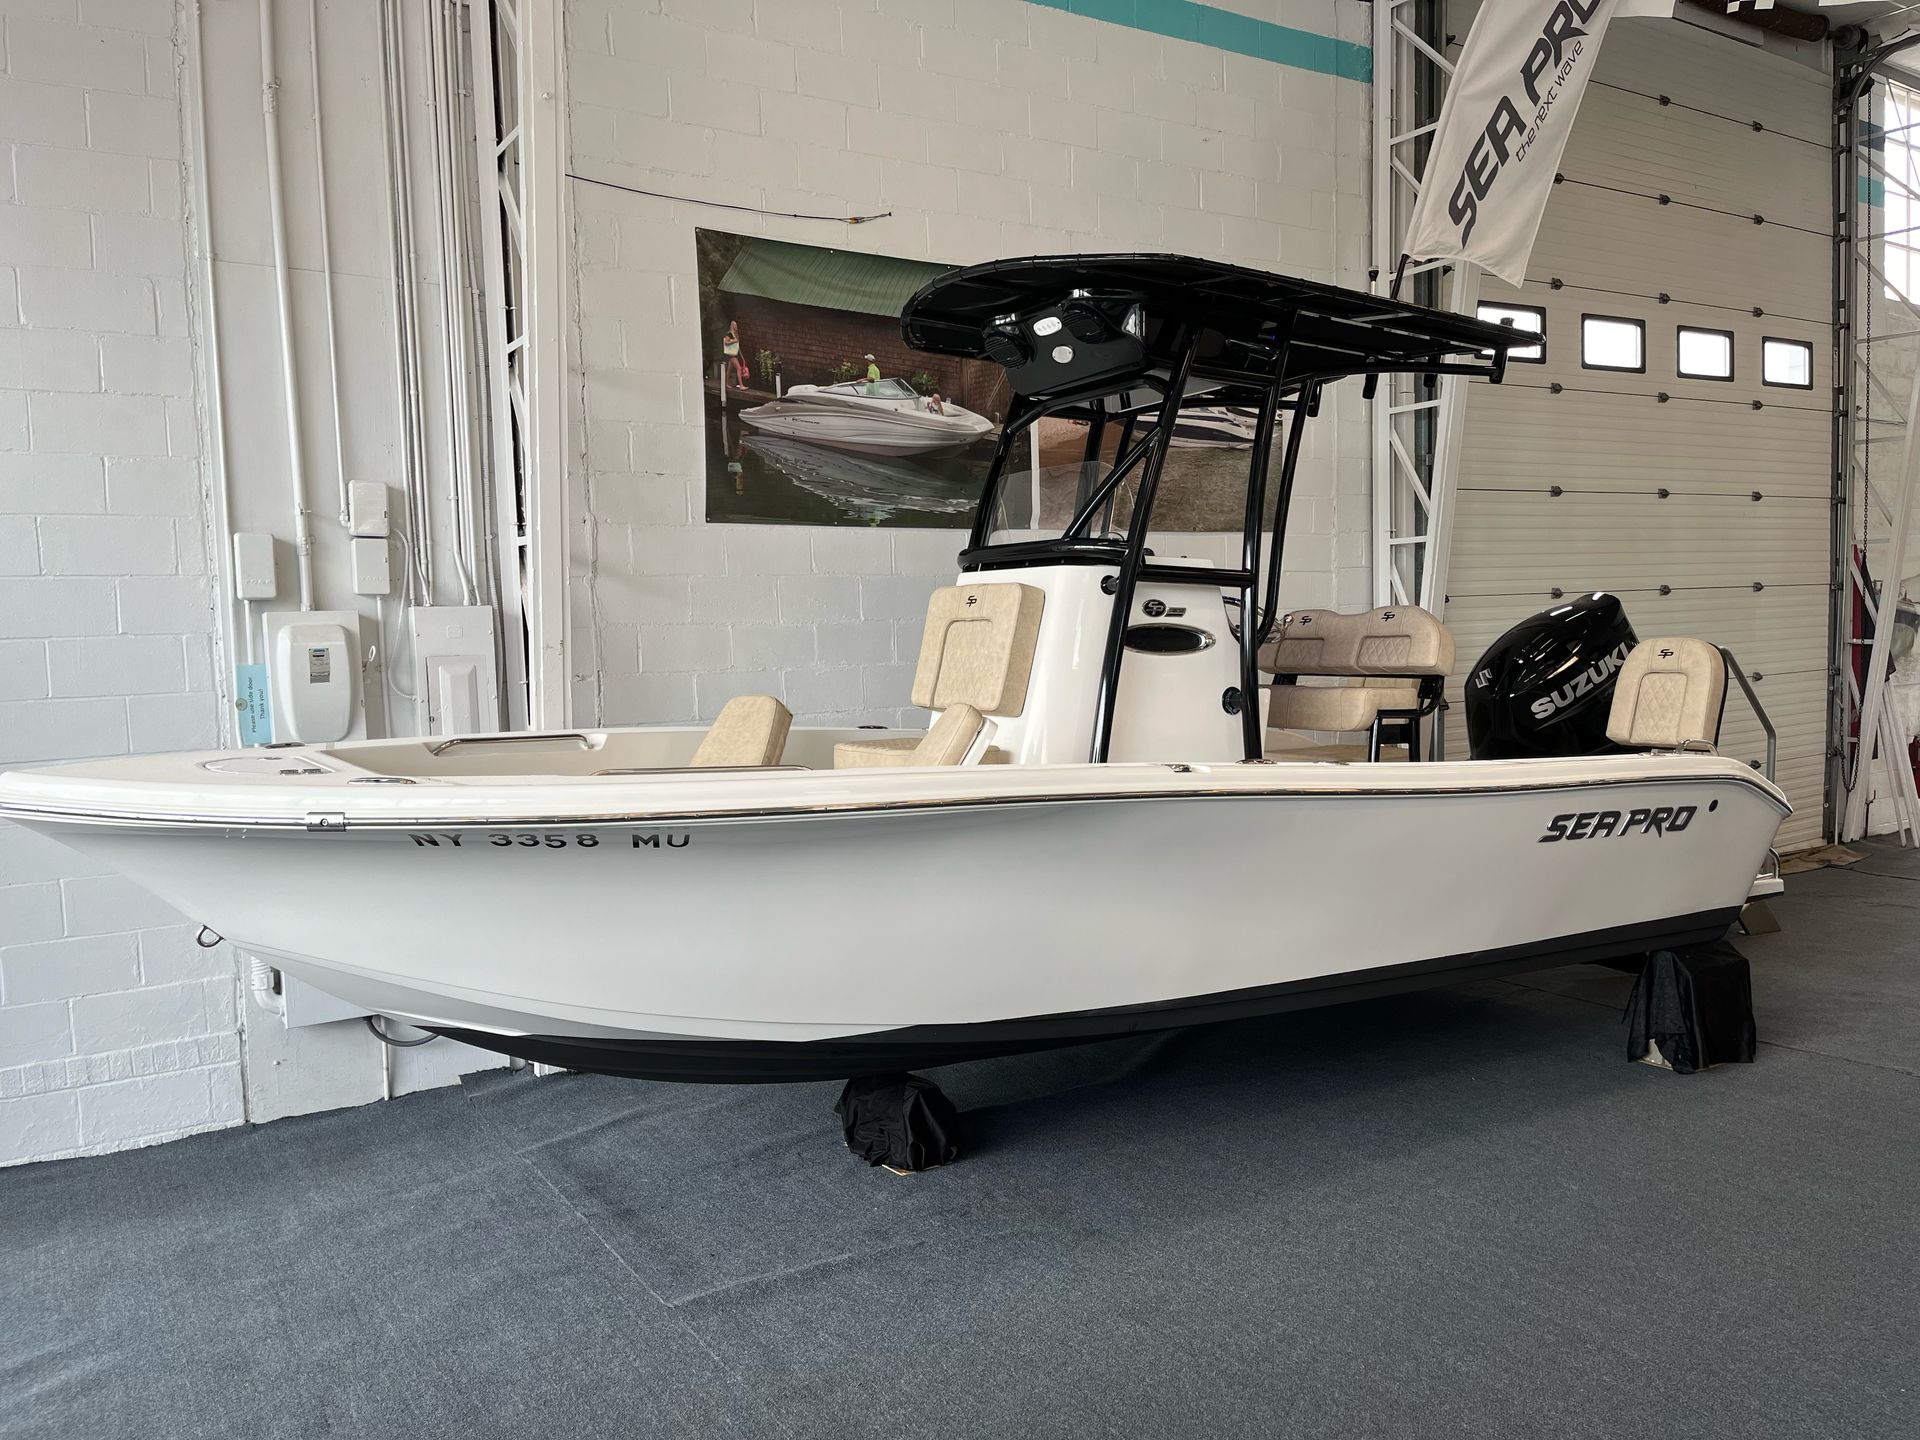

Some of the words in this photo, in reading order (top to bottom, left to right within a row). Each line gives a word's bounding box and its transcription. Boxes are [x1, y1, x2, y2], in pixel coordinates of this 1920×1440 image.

[1516, 128, 1536, 162] the
[1534, 86, 1557, 131] next
[1554, 40, 1584, 87] wave
[1448, 95, 1527, 249] SEA
[1530, 642, 1629, 719] SUZUKI
[407, 833, 463, 847] NY
[487, 833, 600, 849] 3358
[631, 833, 691, 849] MU
[1537, 811, 1622, 843] SEA
[1617, 806, 1698, 838] PRO
